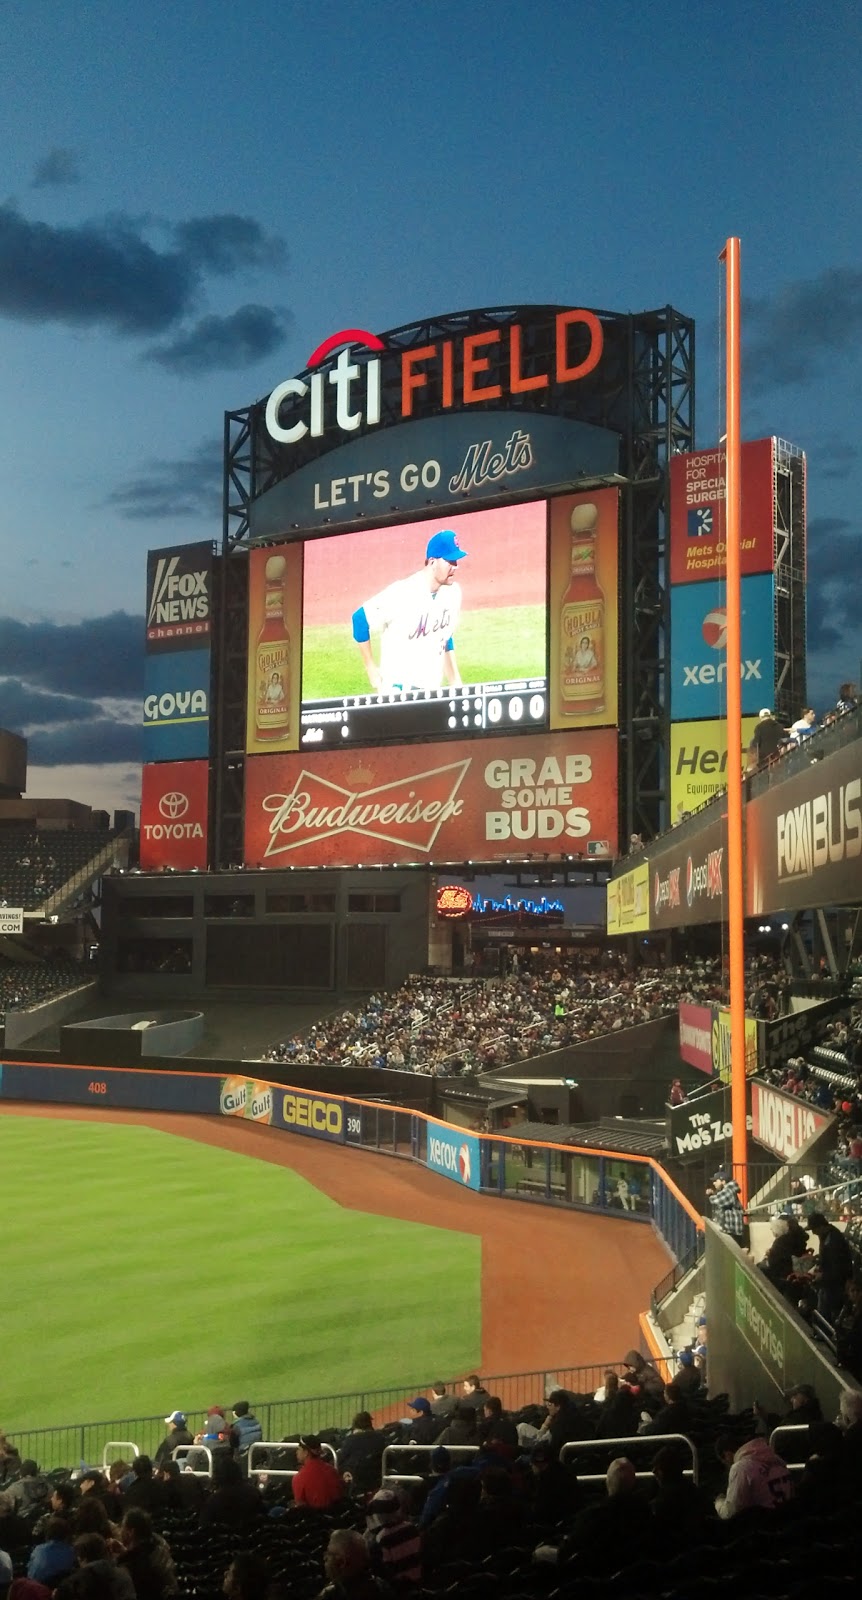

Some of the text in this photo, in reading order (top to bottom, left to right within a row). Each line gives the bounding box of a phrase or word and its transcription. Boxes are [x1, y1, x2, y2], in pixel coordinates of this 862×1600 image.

[401, 309, 604, 417] FIELD
[314, 429, 533, 510] LET'S GO Mets
[686, 452, 728, 469] HOSPITA
[686, 468, 707, 480] FOR
[686, 476, 727, 493] SPECIA
[686, 489, 728, 505] SURGE
[686, 537, 756, 558] Mets Oial
[686, 554, 728, 570] Hospita
[167, 570, 208, 599] FOX
[156, 596, 209, 624] NEWS
[148, 622, 209, 639] channel
[144, 690, 207, 720] GOYA
[488, 694, 544, 723] 0 0 0
[484, 754, 593, 789] GRAB
[676, 745, 747, 776] Her
[501, 787, 573, 808] SOME
[686, 782, 727, 795] Equipme
[262, 791, 464, 834] Budweiser
[143, 823, 204, 840] TOYOTA
[485, 807, 591, 841] BUDS
[88, 1082, 107, 1094] 408
[224, 1088, 247, 1110] Gulf
[252, 1095, 271, 1117] Gulf
[283, 1095, 342, 1134] GEICO
[347, 1117, 361, 1134] 390
[689, 1113, 711, 1128] The
[676, 1114, 752, 1154] Mo's Zoe
[429, 1136, 458, 1174] xerox
